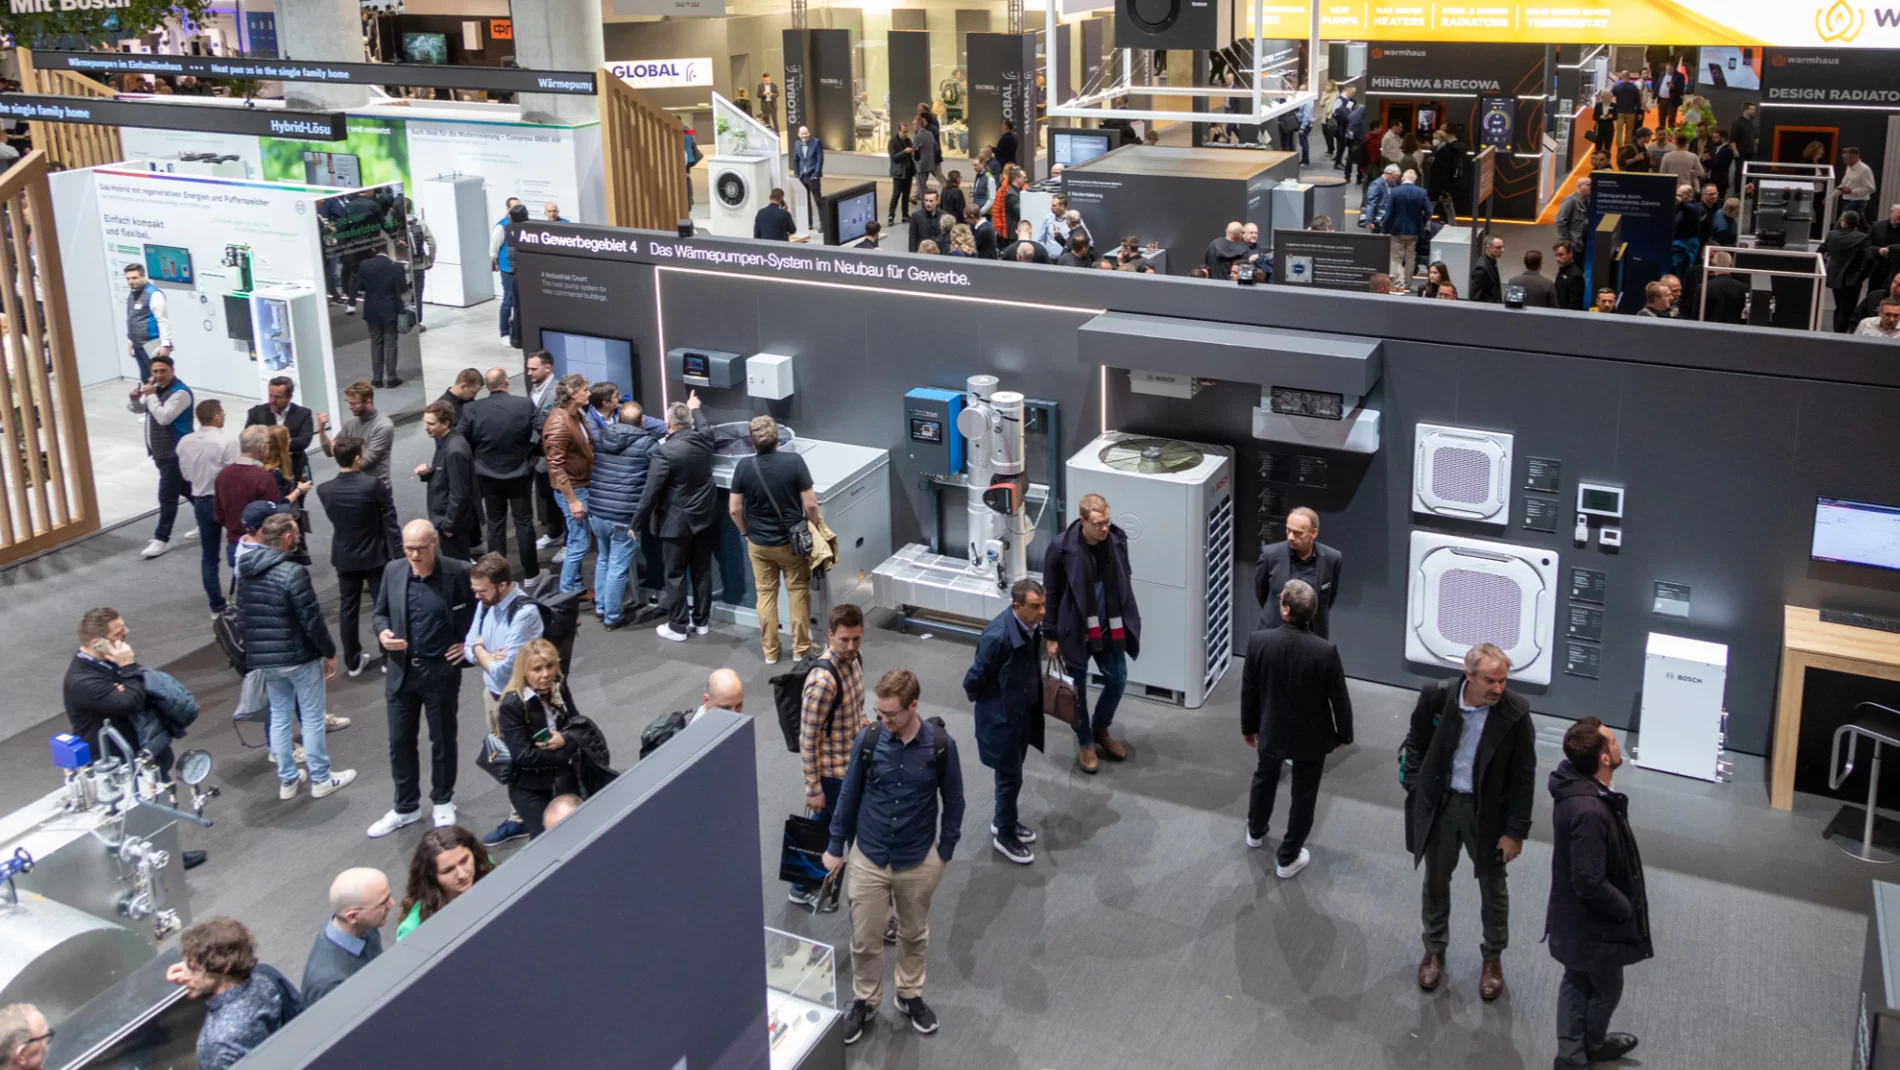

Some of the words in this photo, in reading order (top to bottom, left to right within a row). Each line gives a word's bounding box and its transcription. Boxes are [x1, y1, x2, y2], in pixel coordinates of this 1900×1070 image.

[10, 0, 54, 14] Mit
[1321, 16, 1359, 26] PUMPS
[1373, 16, 1425, 26] HEATERS
[1440, 18, 1509, 27] RADIATORS
[1384, 49, 1427, 57] warmhaus
[1787, 56, 1840, 65] warmhaus
[211, 64, 229, 74] Heat
[256, 66, 264, 75] in
[265, 66, 277, 76] the
[278, 67, 301, 78] single
[302, 68, 326, 80] family
[328, 69, 350, 78] home
[612, 64, 680, 79] GLOBAL
[1372, 78, 1431, 88] MINERWA
[1433, 80, 1442, 89] &
[1444, 80, 1500, 90] RECOWA
[786, 76, 797, 125] GLOBAL
[1769, 88, 1825, 100] DESIGN
[1830, 89, 1900, 102] RADIATO
[1002, 84, 1012, 121] OBAL
[0, 102, 10, 113] he
[11, 104, 36, 117] single
[38, 104, 64, 119] family
[65, 106, 91, 118] home
[184, 191, 210, 202] Energien
[104, 214, 130, 224] Einfach
[132, 216, 164, 229] kompakt
[106, 228, 119, 236] und
[519, 230, 538, 244] Am
[540, 232, 628, 253] Gewerbegebiet
[629, 240, 638, 254] 4
[650, 242, 672, 257] Das
[676, 244, 812, 270] Wärmepumpen-System
[815, 258, 831, 272] im
[834, 260, 884, 278] Neubau
[886, 264, 904, 279] für
[908, 266, 971, 286] Gewerbe.
[572, 274, 588, 282] Court
[1677, 674, 1702, 684] BOSCH
